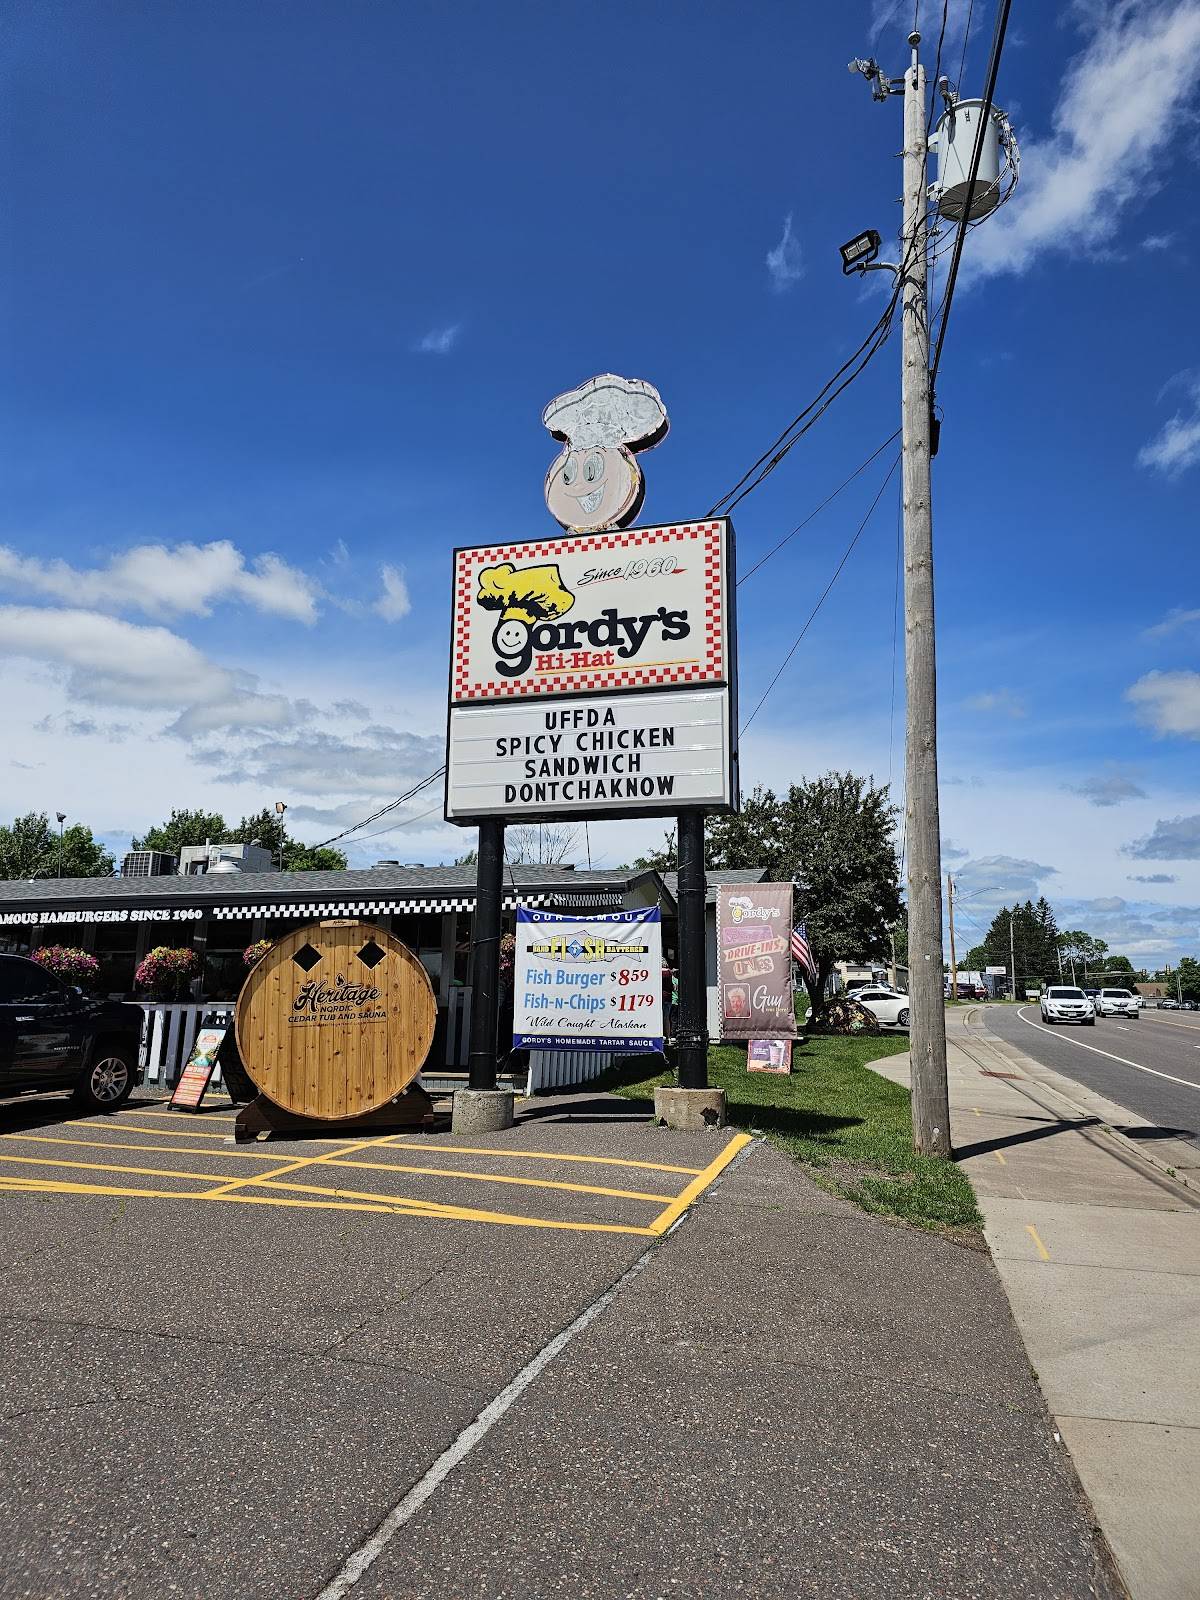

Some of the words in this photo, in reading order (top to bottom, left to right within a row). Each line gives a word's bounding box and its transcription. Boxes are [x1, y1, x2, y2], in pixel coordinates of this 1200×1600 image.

[577, 567, 622, 586] Since
[623, 556, 678, 581] 1960
[492, 606, 691, 677] gordy's
[534, 649, 615, 672] Hi-Hat
[545, 707, 616, 730] UFFDA
[496, 734, 562, 757] SPICY
[576, 727, 675, 751] CHICKEN
[525, 753, 641, 779] SANDWICH
[505, 775, 675, 803] DONTCHAKNOW
[39, 910, 129, 923] HAMBURGERS
[130, 909, 170, 921] SINCE
[172, 909, 203, 921] 1960
[526, 969, 551, 985] Fish
[556, 970, 605, 988] Burger
[292, 979, 382, 1013] Heritage
[753, 985, 782, 1017] Guy
[320, 1005, 353, 1013] NORDIC
[357, 1011, 386, 1019] SAUNA
[526, 1016, 555, 1028] Wild
[557, 1017, 599, 1031] Caught
[600, 1018, 648, 1029] Alaskan
